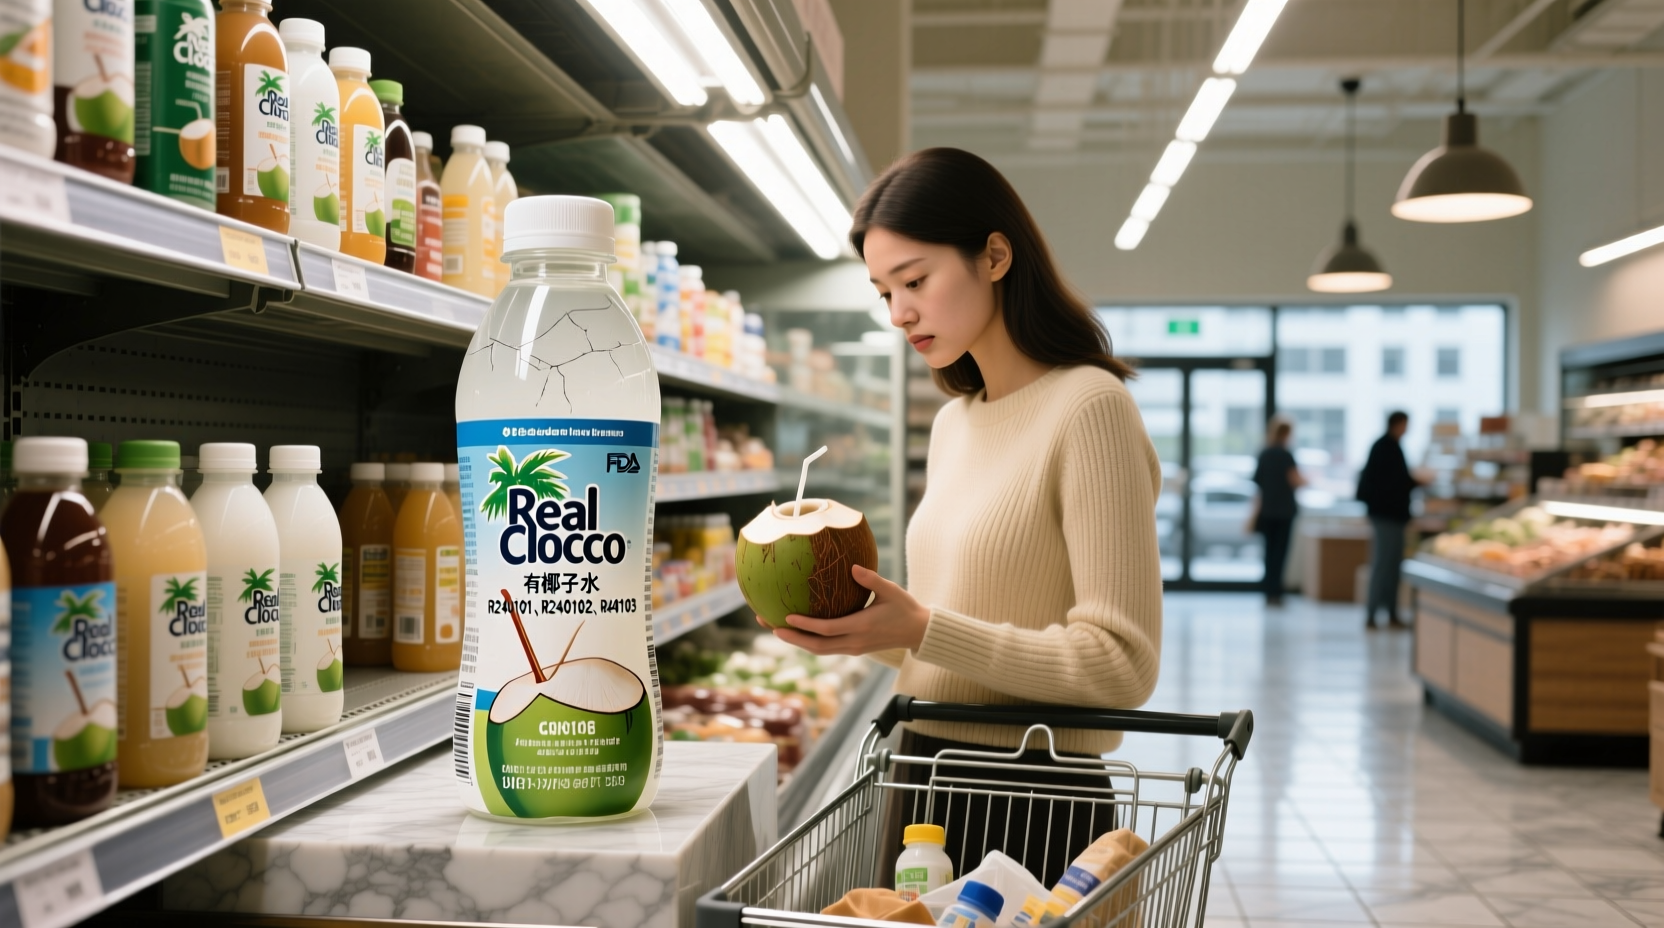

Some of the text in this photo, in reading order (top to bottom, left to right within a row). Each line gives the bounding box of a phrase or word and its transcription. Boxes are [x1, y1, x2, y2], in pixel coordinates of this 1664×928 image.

[606, 452, 641, 474] FDA
[509, 486, 598, 532] Real
[500, 525, 626, 566] Clocco
